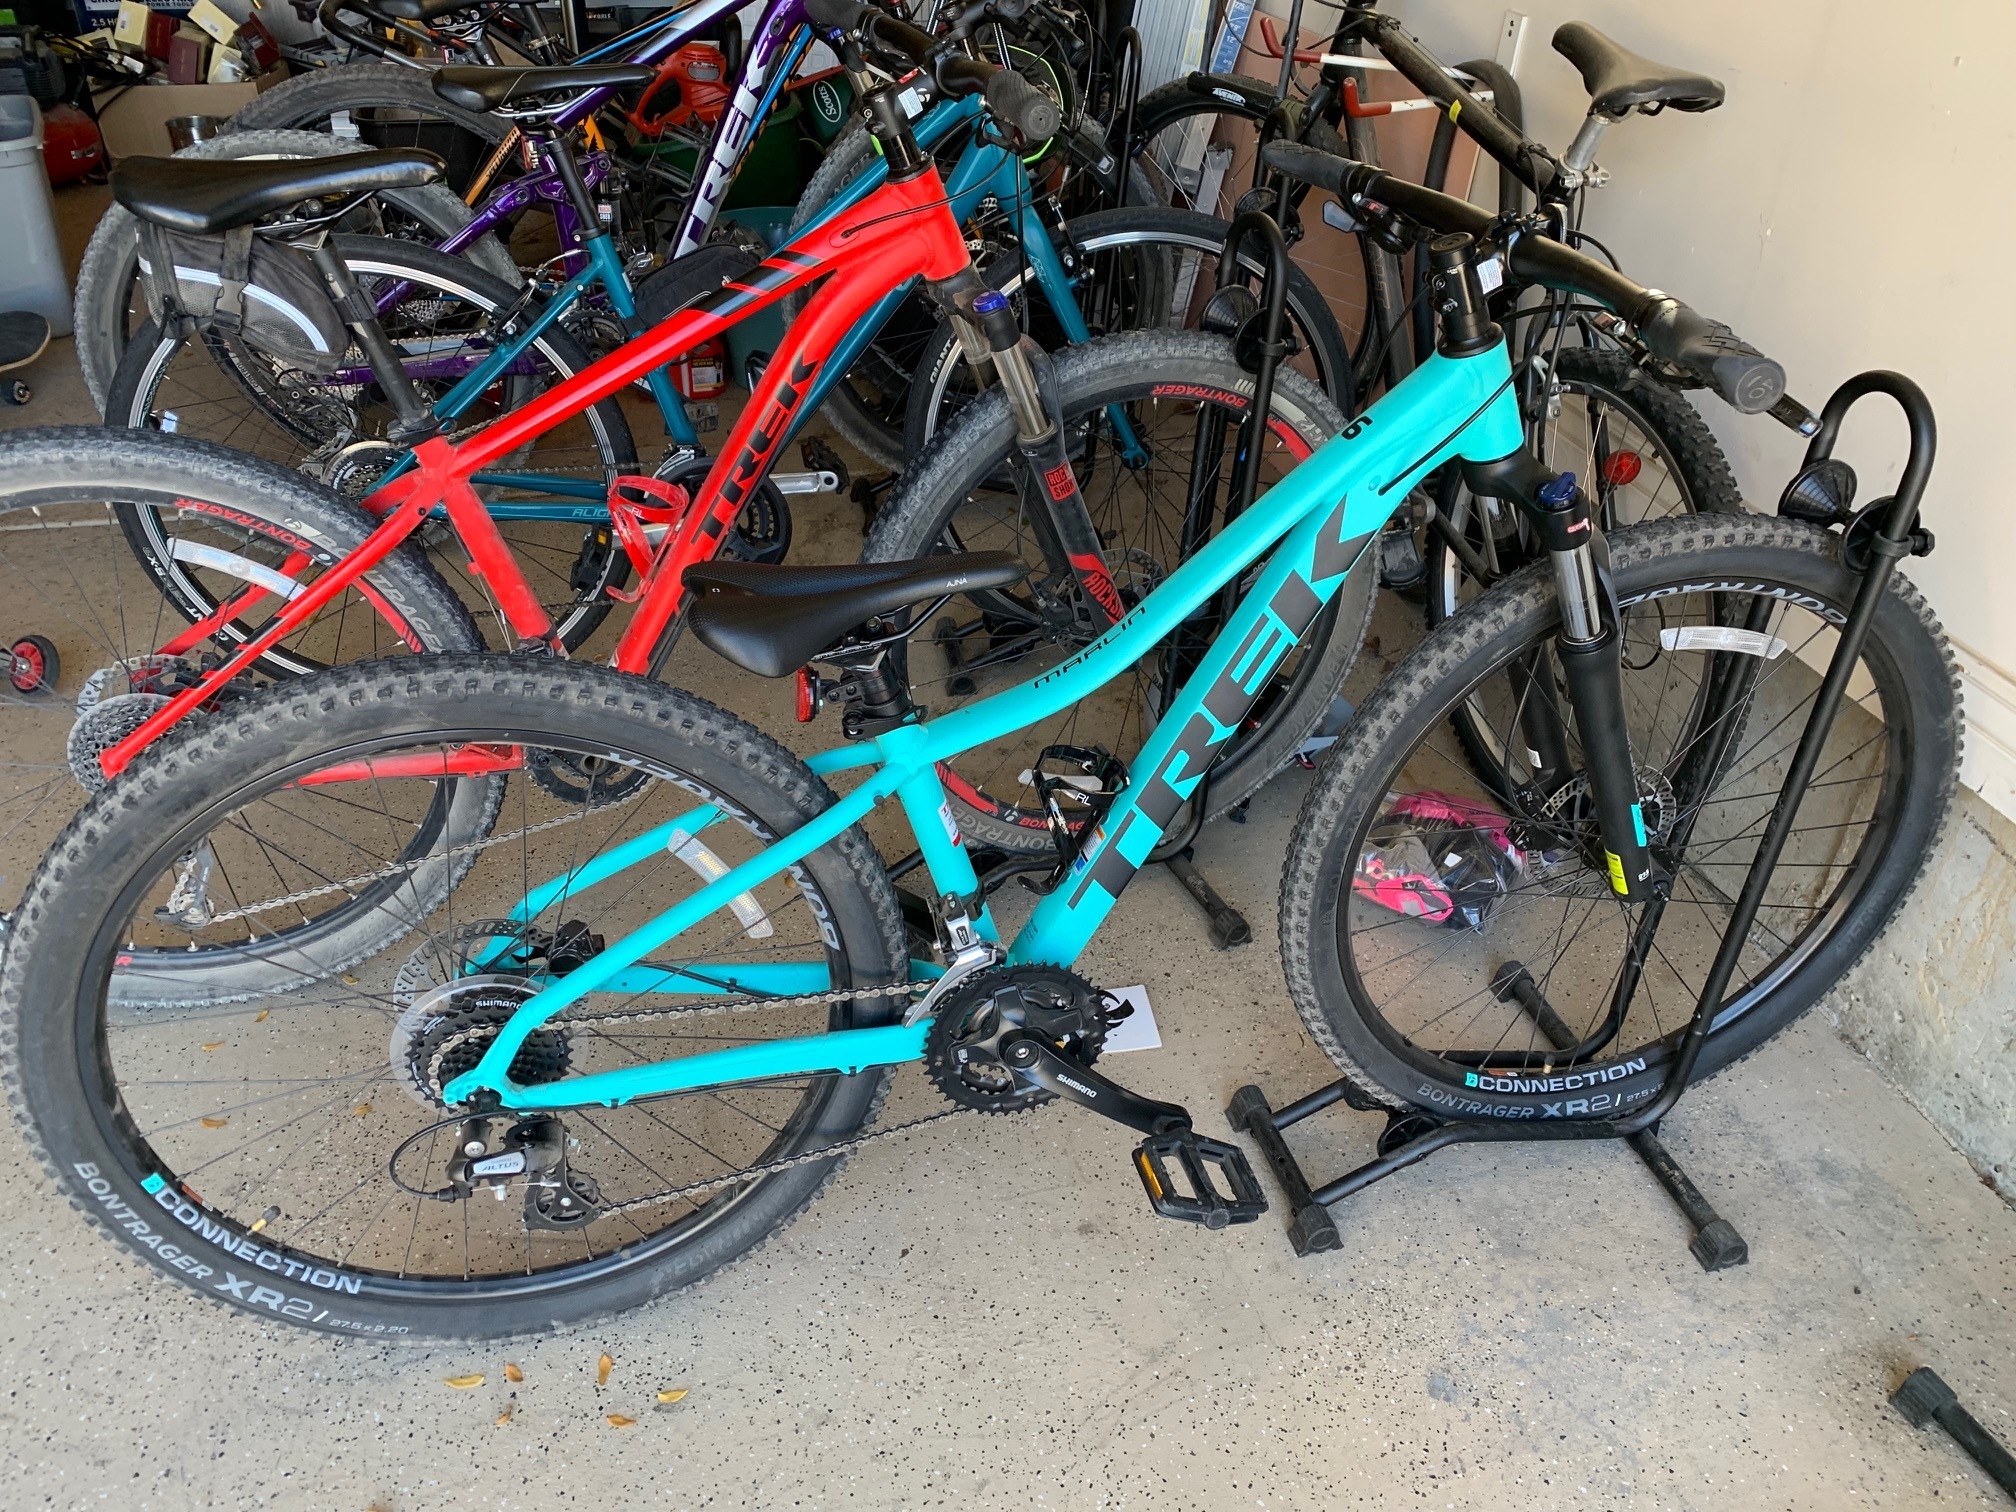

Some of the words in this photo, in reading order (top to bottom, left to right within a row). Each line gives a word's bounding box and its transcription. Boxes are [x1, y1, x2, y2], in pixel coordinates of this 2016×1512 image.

[817, 84, 838, 117] Scotts
[674, 44, 767, 260] TREK
[930, 338, 952, 384] GIANT
[1151, 384, 1249, 409] BONTRAGER
[1341, 415, 1373, 440] 6
[690, 350, 821, 545] TREK
[1048, 462, 1071, 487] ROCK
[1053, 477, 1076, 499] SHOX
[173, 497, 313, 551] BONTRAGER
[1033, 606, 1146, 689] MARLIN
[1067, 490, 1380, 911] TREK
[1075, 792, 1092, 806] RL
[1056, 1073, 1098, 1099] SHIMANO
[1478, 1057, 1647, 1093] CONNECTION
[1417, 1082, 1535, 1120] BONTRAGER
[481, 1161, 519, 1172] ALTUS
[73, 1161, 214, 1281] BONTRAGER
[328, 1318, 362, 1331] 27.5
[154, 1187, 362, 1295] CONNECTION
